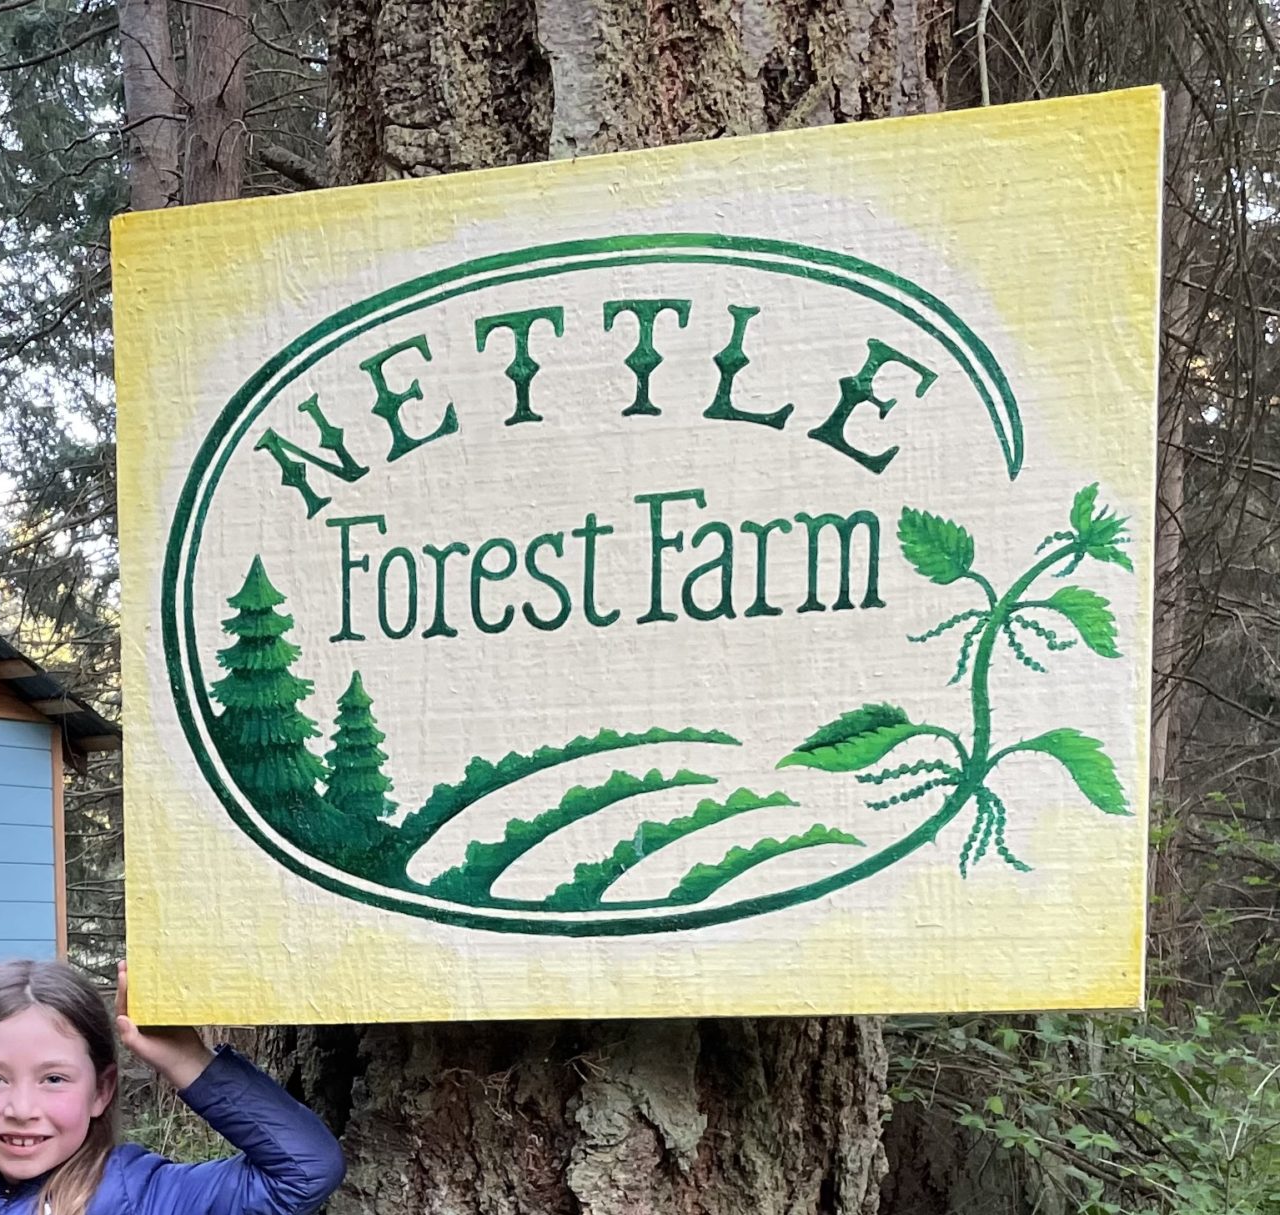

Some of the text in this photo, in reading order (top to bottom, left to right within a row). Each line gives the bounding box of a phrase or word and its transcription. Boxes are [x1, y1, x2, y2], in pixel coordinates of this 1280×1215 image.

[253, 298, 939, 520] NETTLE
[325, 487, 887, 643] Forest Farm
